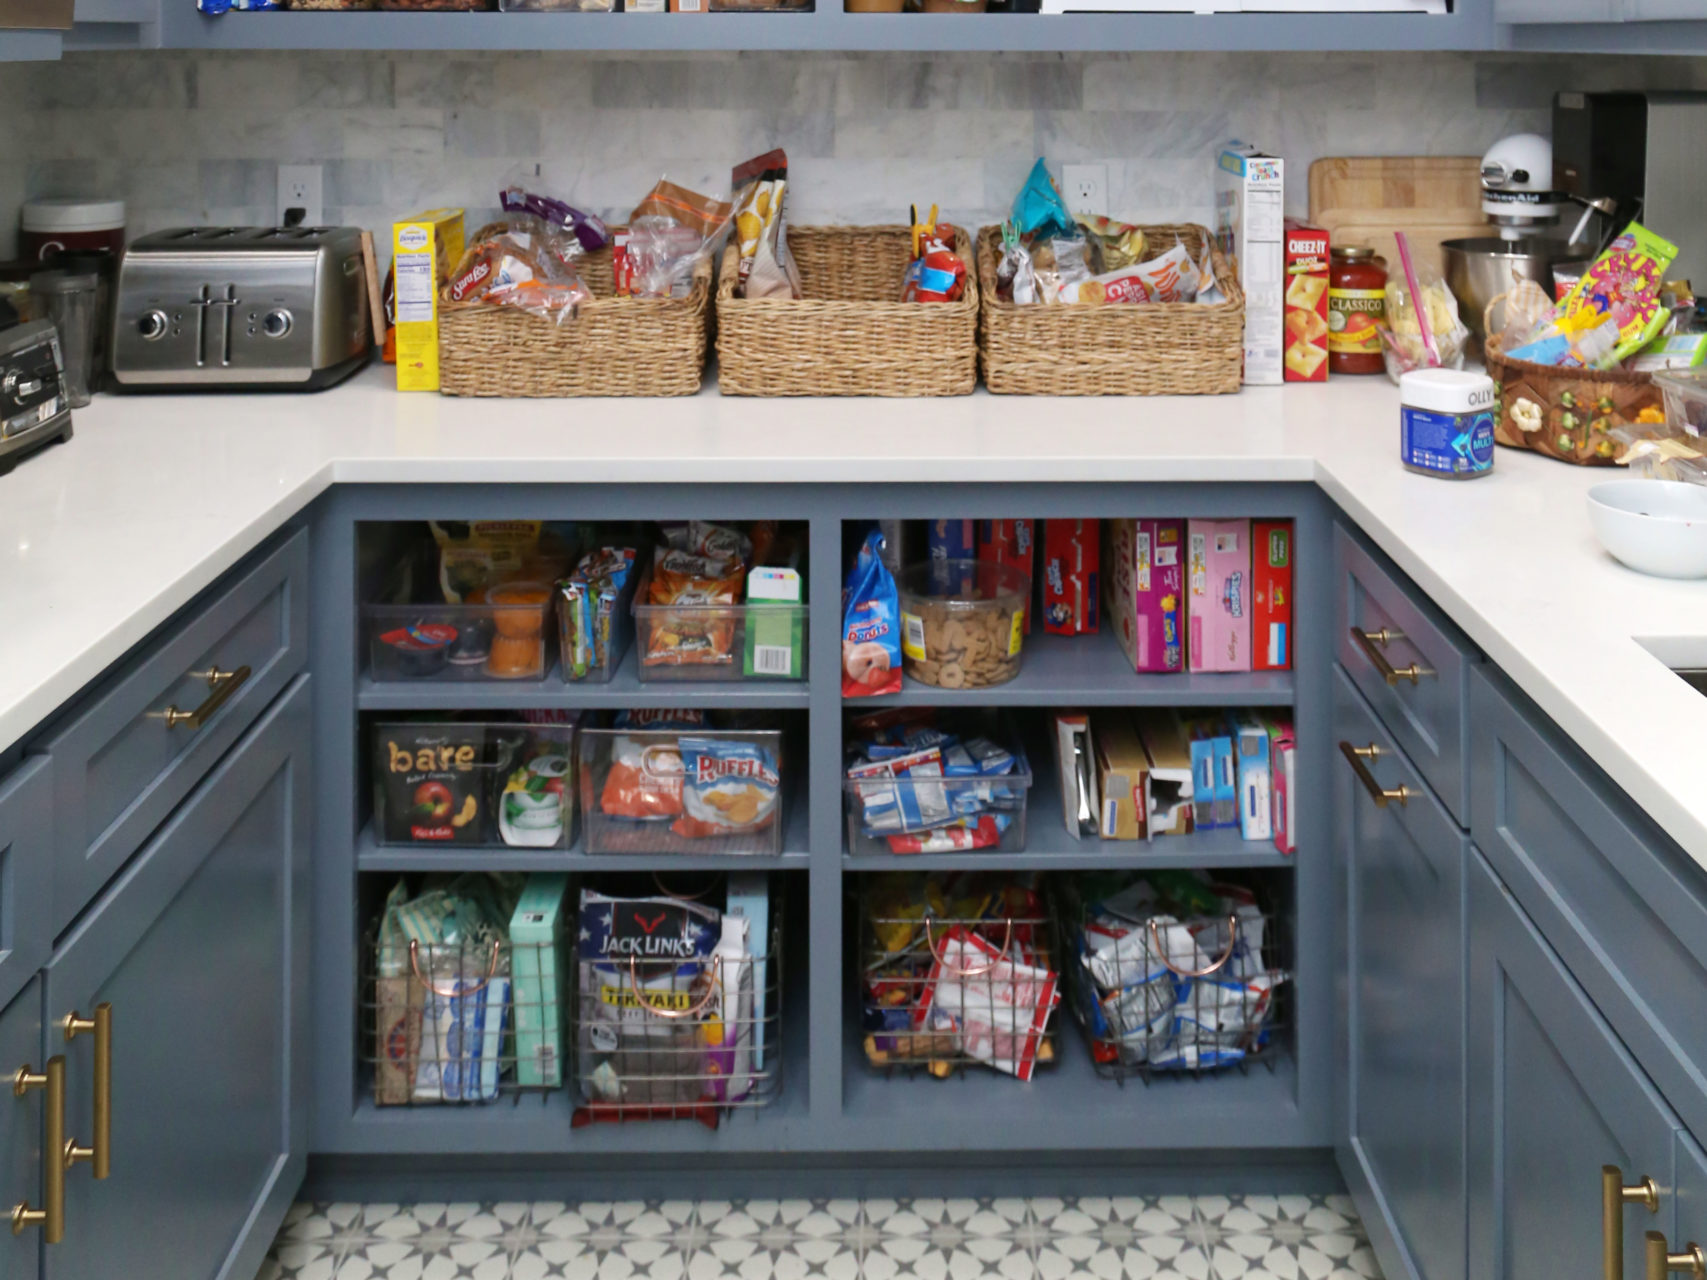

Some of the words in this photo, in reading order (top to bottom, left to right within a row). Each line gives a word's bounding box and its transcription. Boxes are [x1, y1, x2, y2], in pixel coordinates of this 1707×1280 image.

[1331, 299, 1382, 312] CLASSICO
[1468, 389, 1493, 406] OLLY
[1231, 572, 1243, 618] KRISPIES
[848, 624, 889, 641] Donuts
[388, 741, 475, 773] bare
[600, 936, 640, 955] JACK
